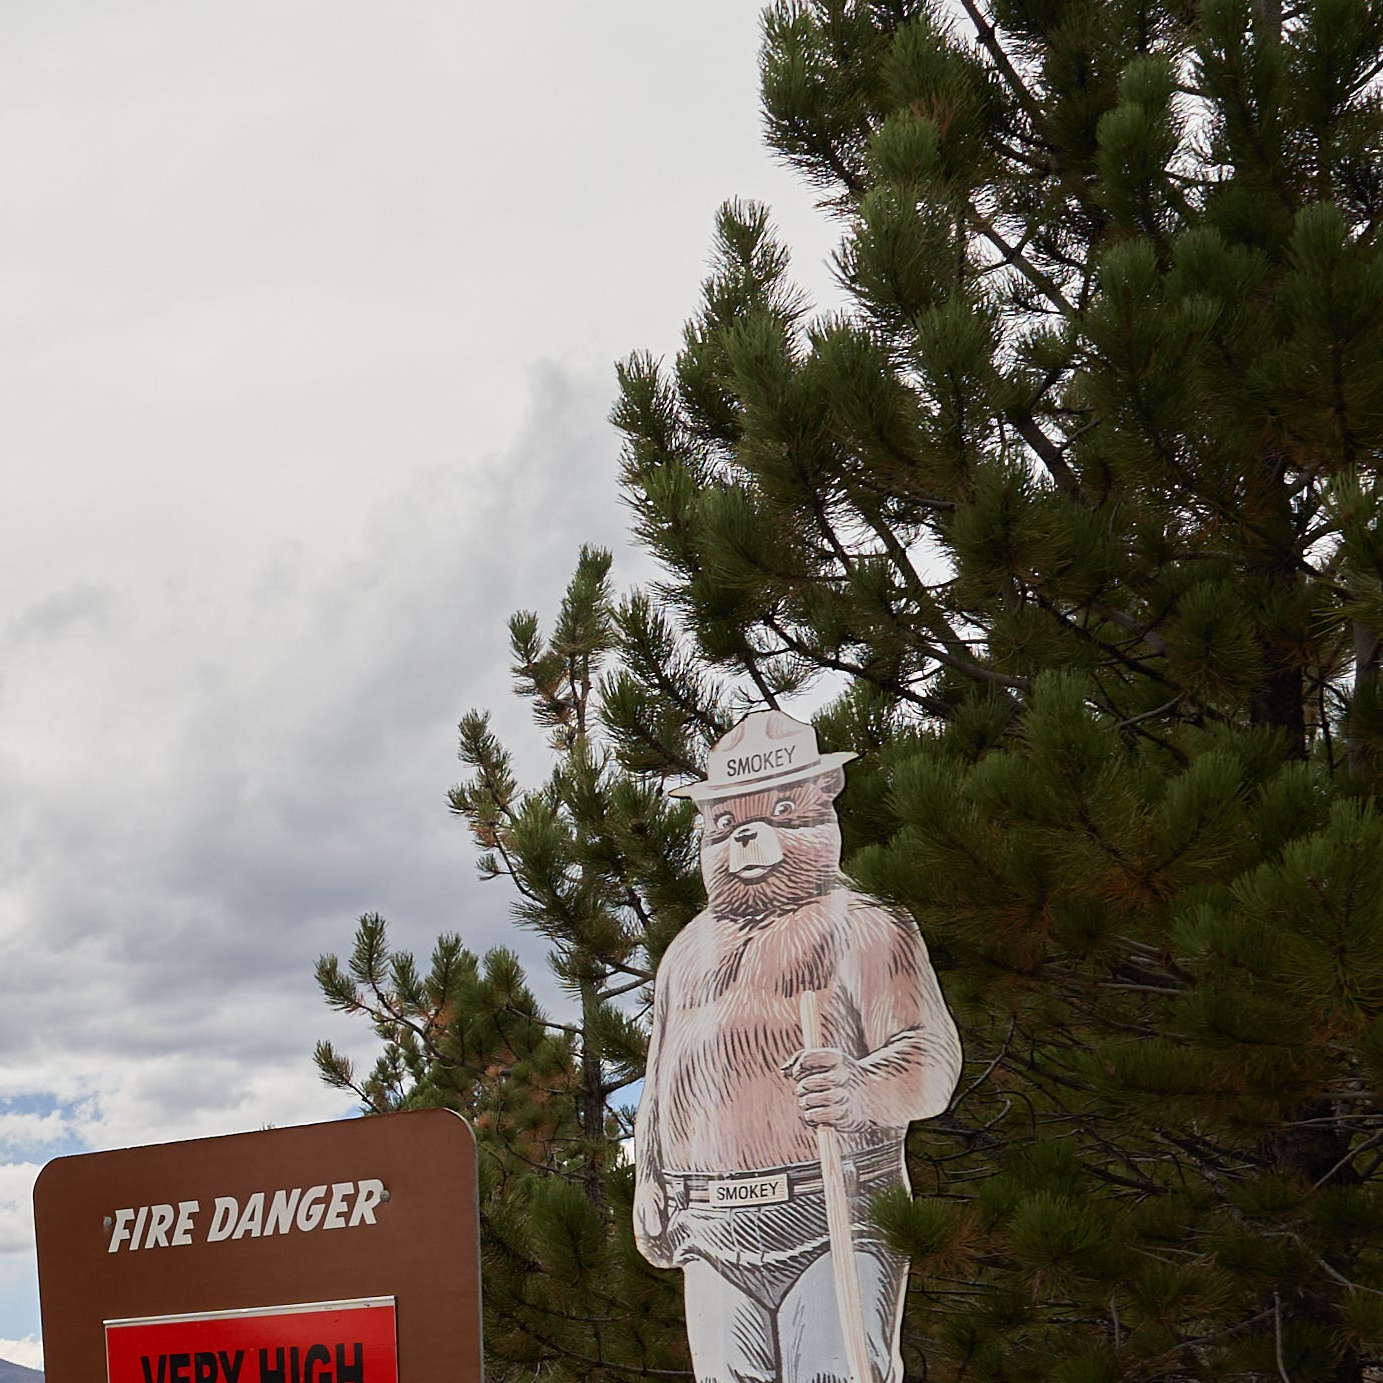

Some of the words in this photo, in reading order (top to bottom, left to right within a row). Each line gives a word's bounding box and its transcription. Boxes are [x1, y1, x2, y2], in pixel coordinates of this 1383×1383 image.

[727, 745, 796, 777] SMOKEY
[717, 1181, 779, 1201] SMOKEY
[108, 1200, 200, 1253] FIRE
[206, 1178, 384, 1244] DANGER
